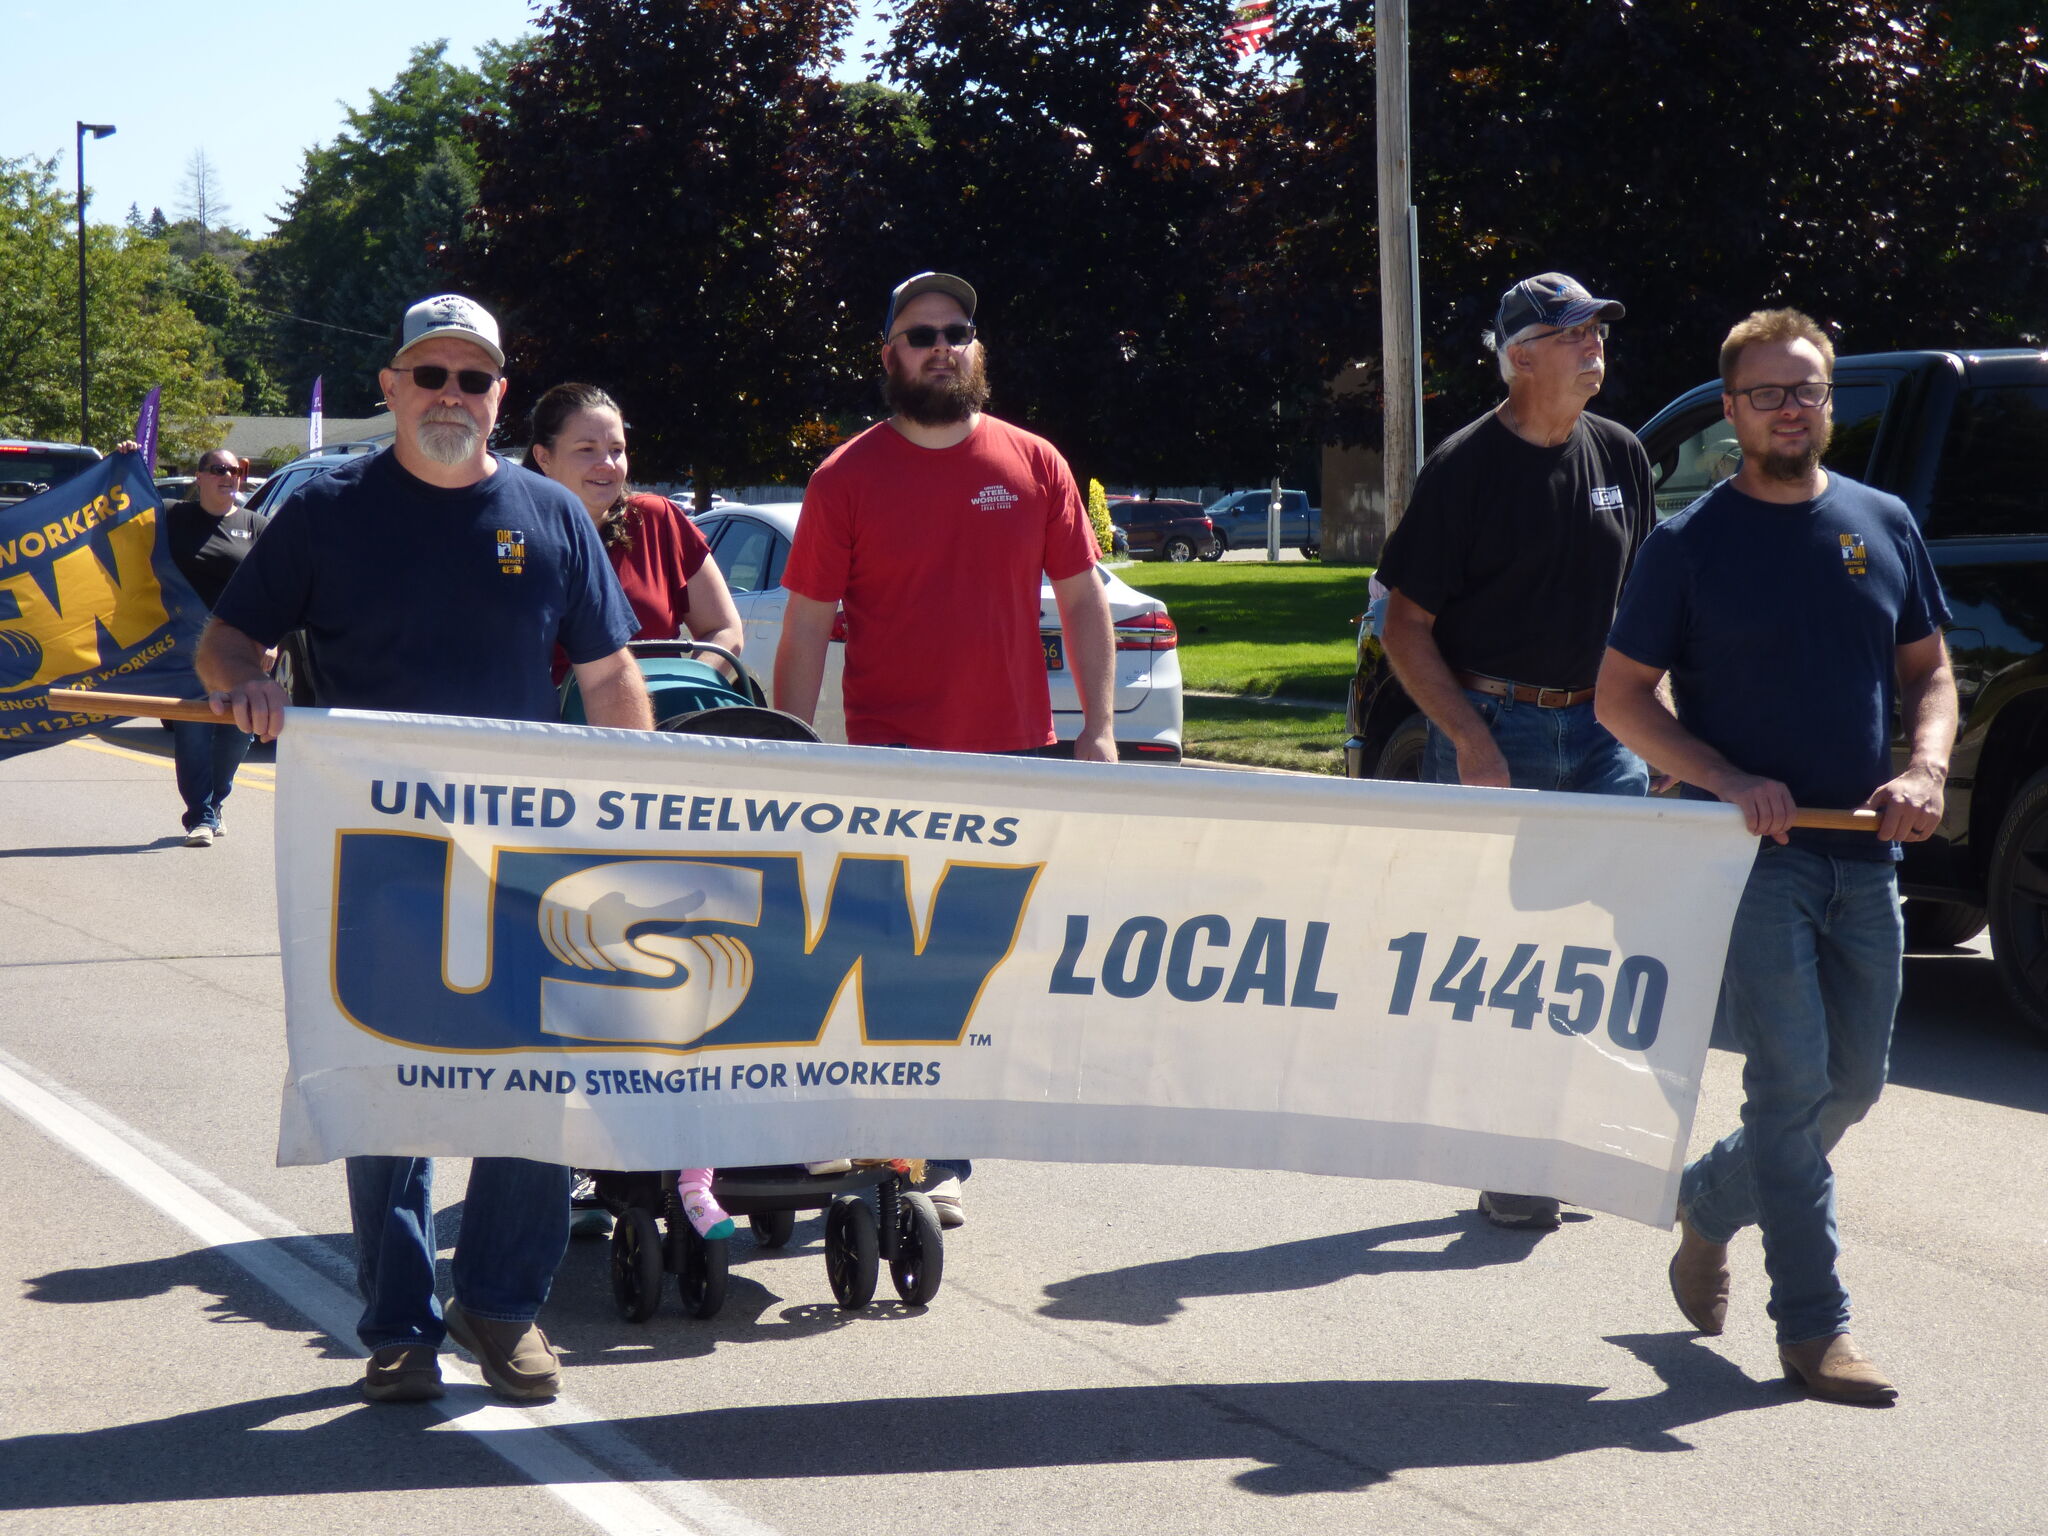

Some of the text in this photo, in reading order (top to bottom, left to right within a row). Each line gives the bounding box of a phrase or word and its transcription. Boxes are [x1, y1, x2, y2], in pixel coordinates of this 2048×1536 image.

[970, 494, 1019, 505] WORKERS
[979, 489, 1010, 497] STEEL
[497, 530, 510, 543] OH
[99, 634, 175, 681] WORKERS
[370, 780, 1020, 848] UNITED STEELWORKERS
[330, 828, 1048, 1055] USW
[1048, 914, 1669, 1052] LOCAL 14450
[397, 1061, 941, 1096] UNITY AND STRENGTH FOR WORKERS
